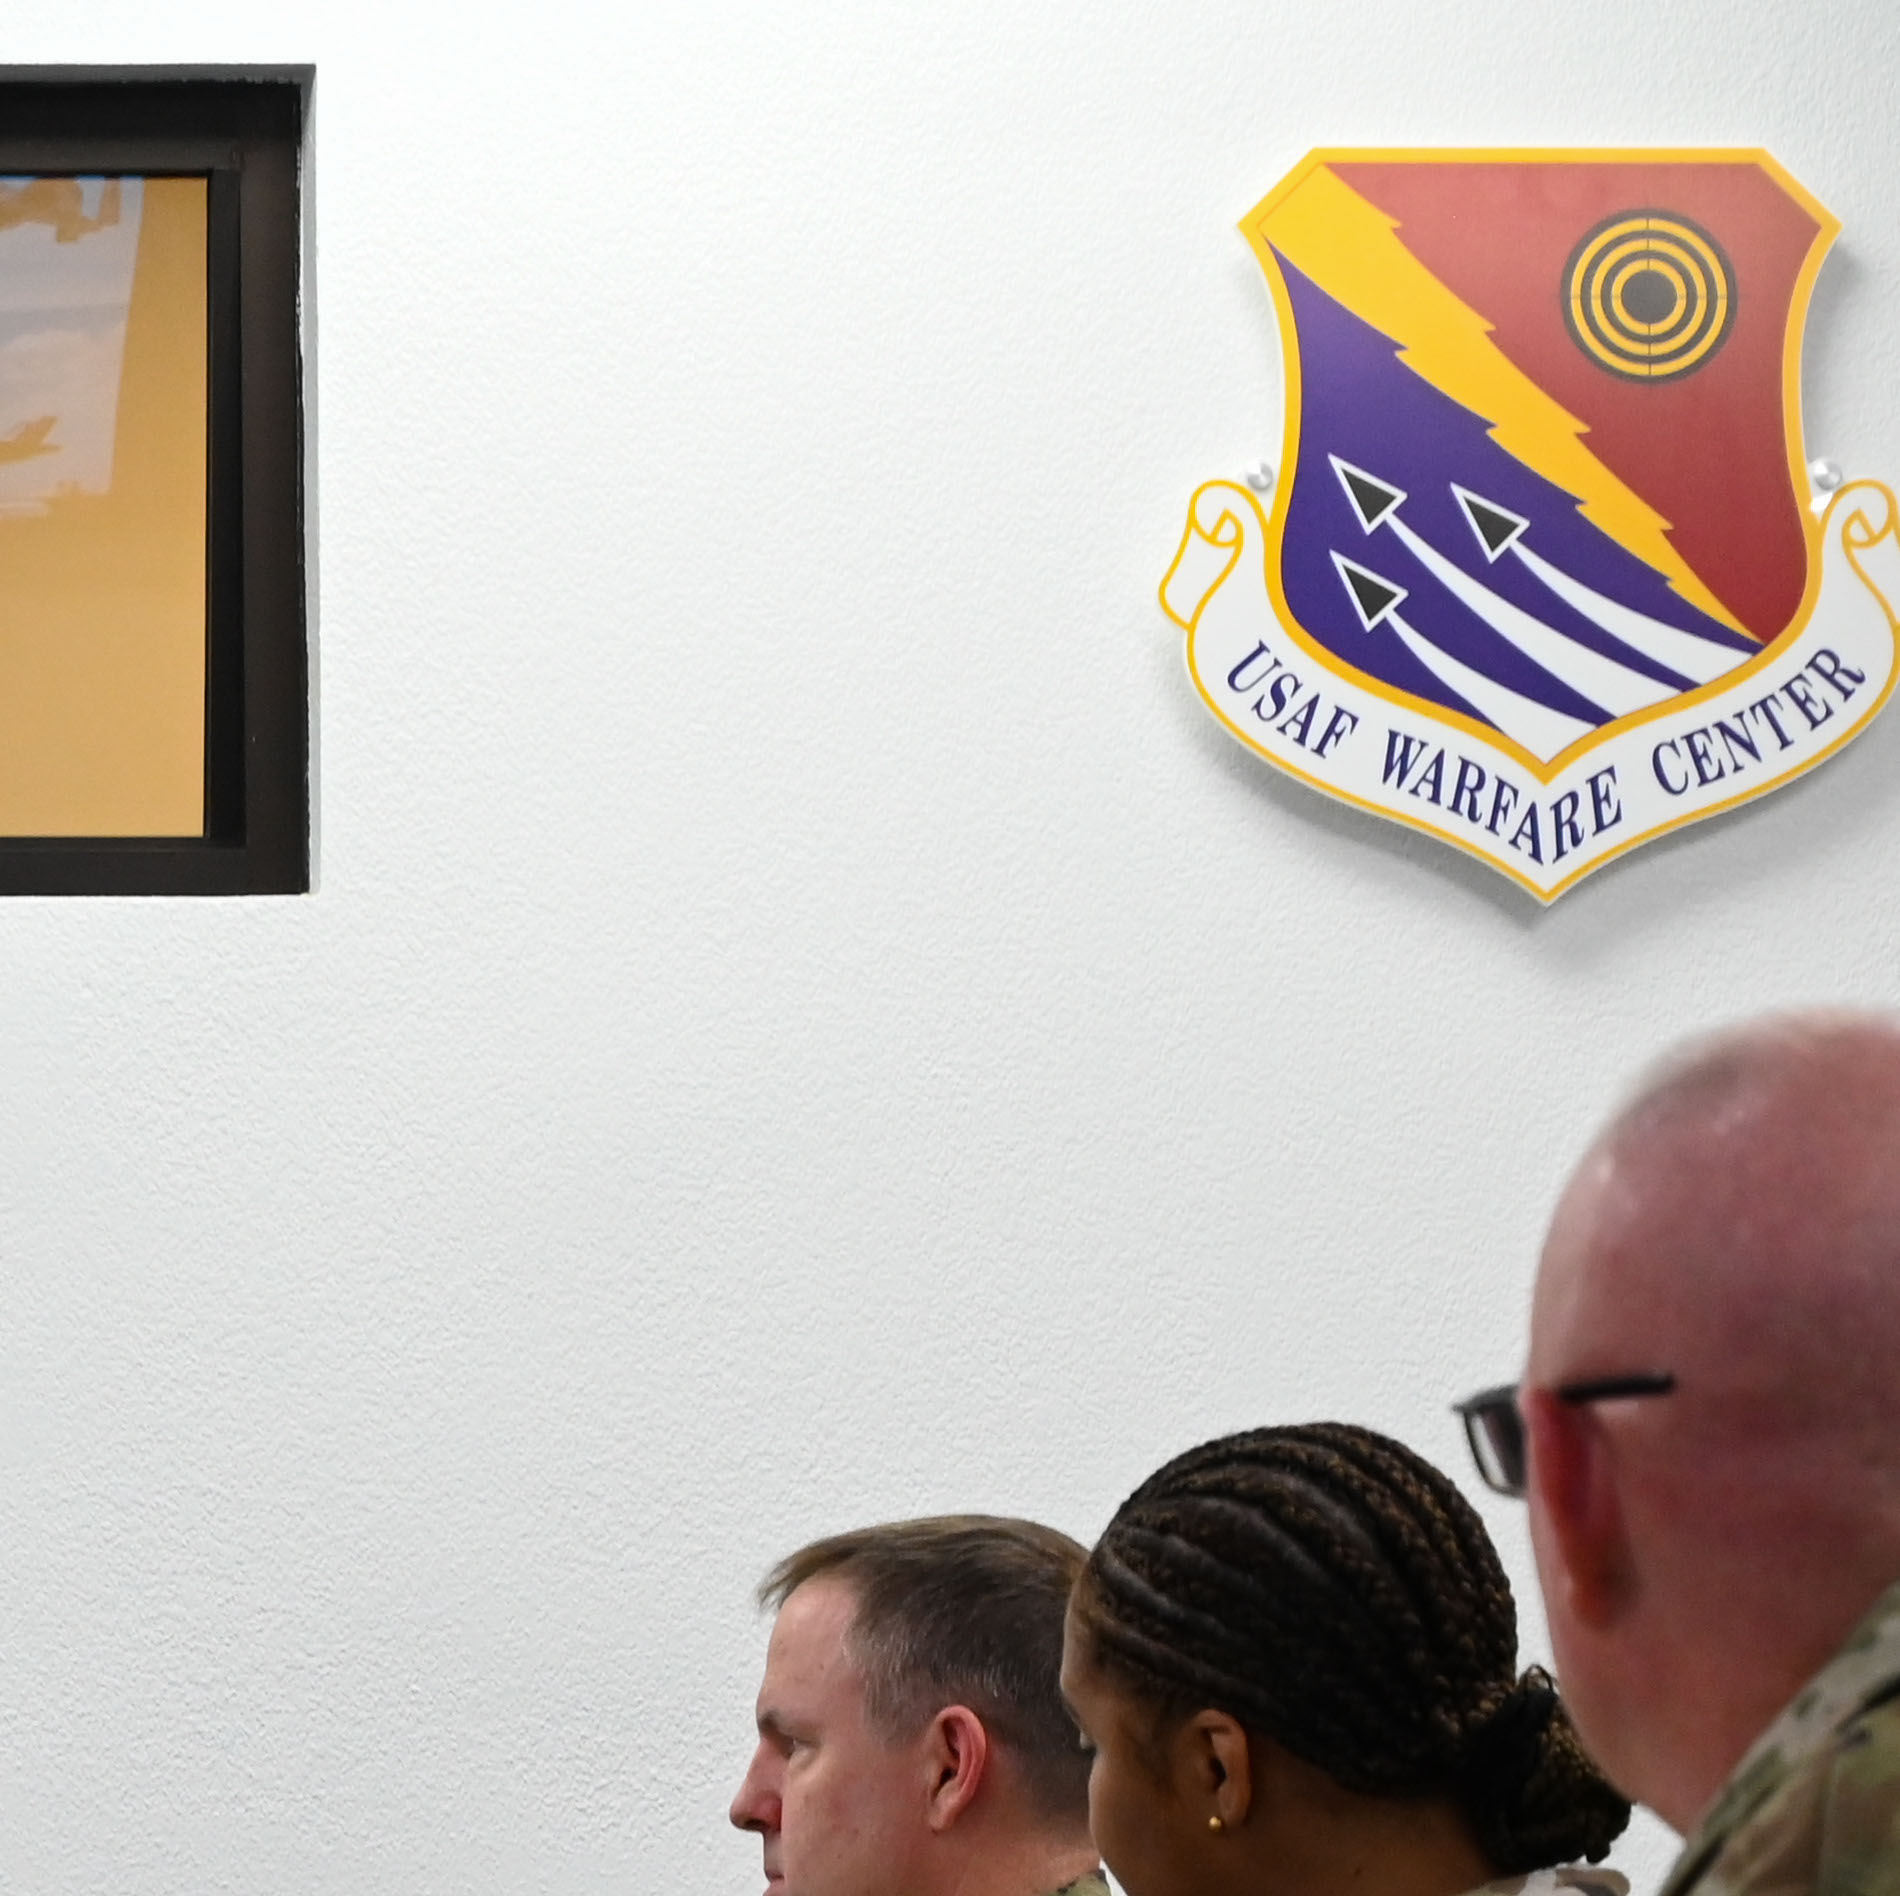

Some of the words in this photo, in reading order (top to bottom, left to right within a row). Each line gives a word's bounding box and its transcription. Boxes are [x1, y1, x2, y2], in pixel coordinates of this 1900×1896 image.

[1226, 638, 1359, 760] USAF
[1379, 727, 1623, 868] WARFARE
[1650, 645, 1867, 798] CENTER
